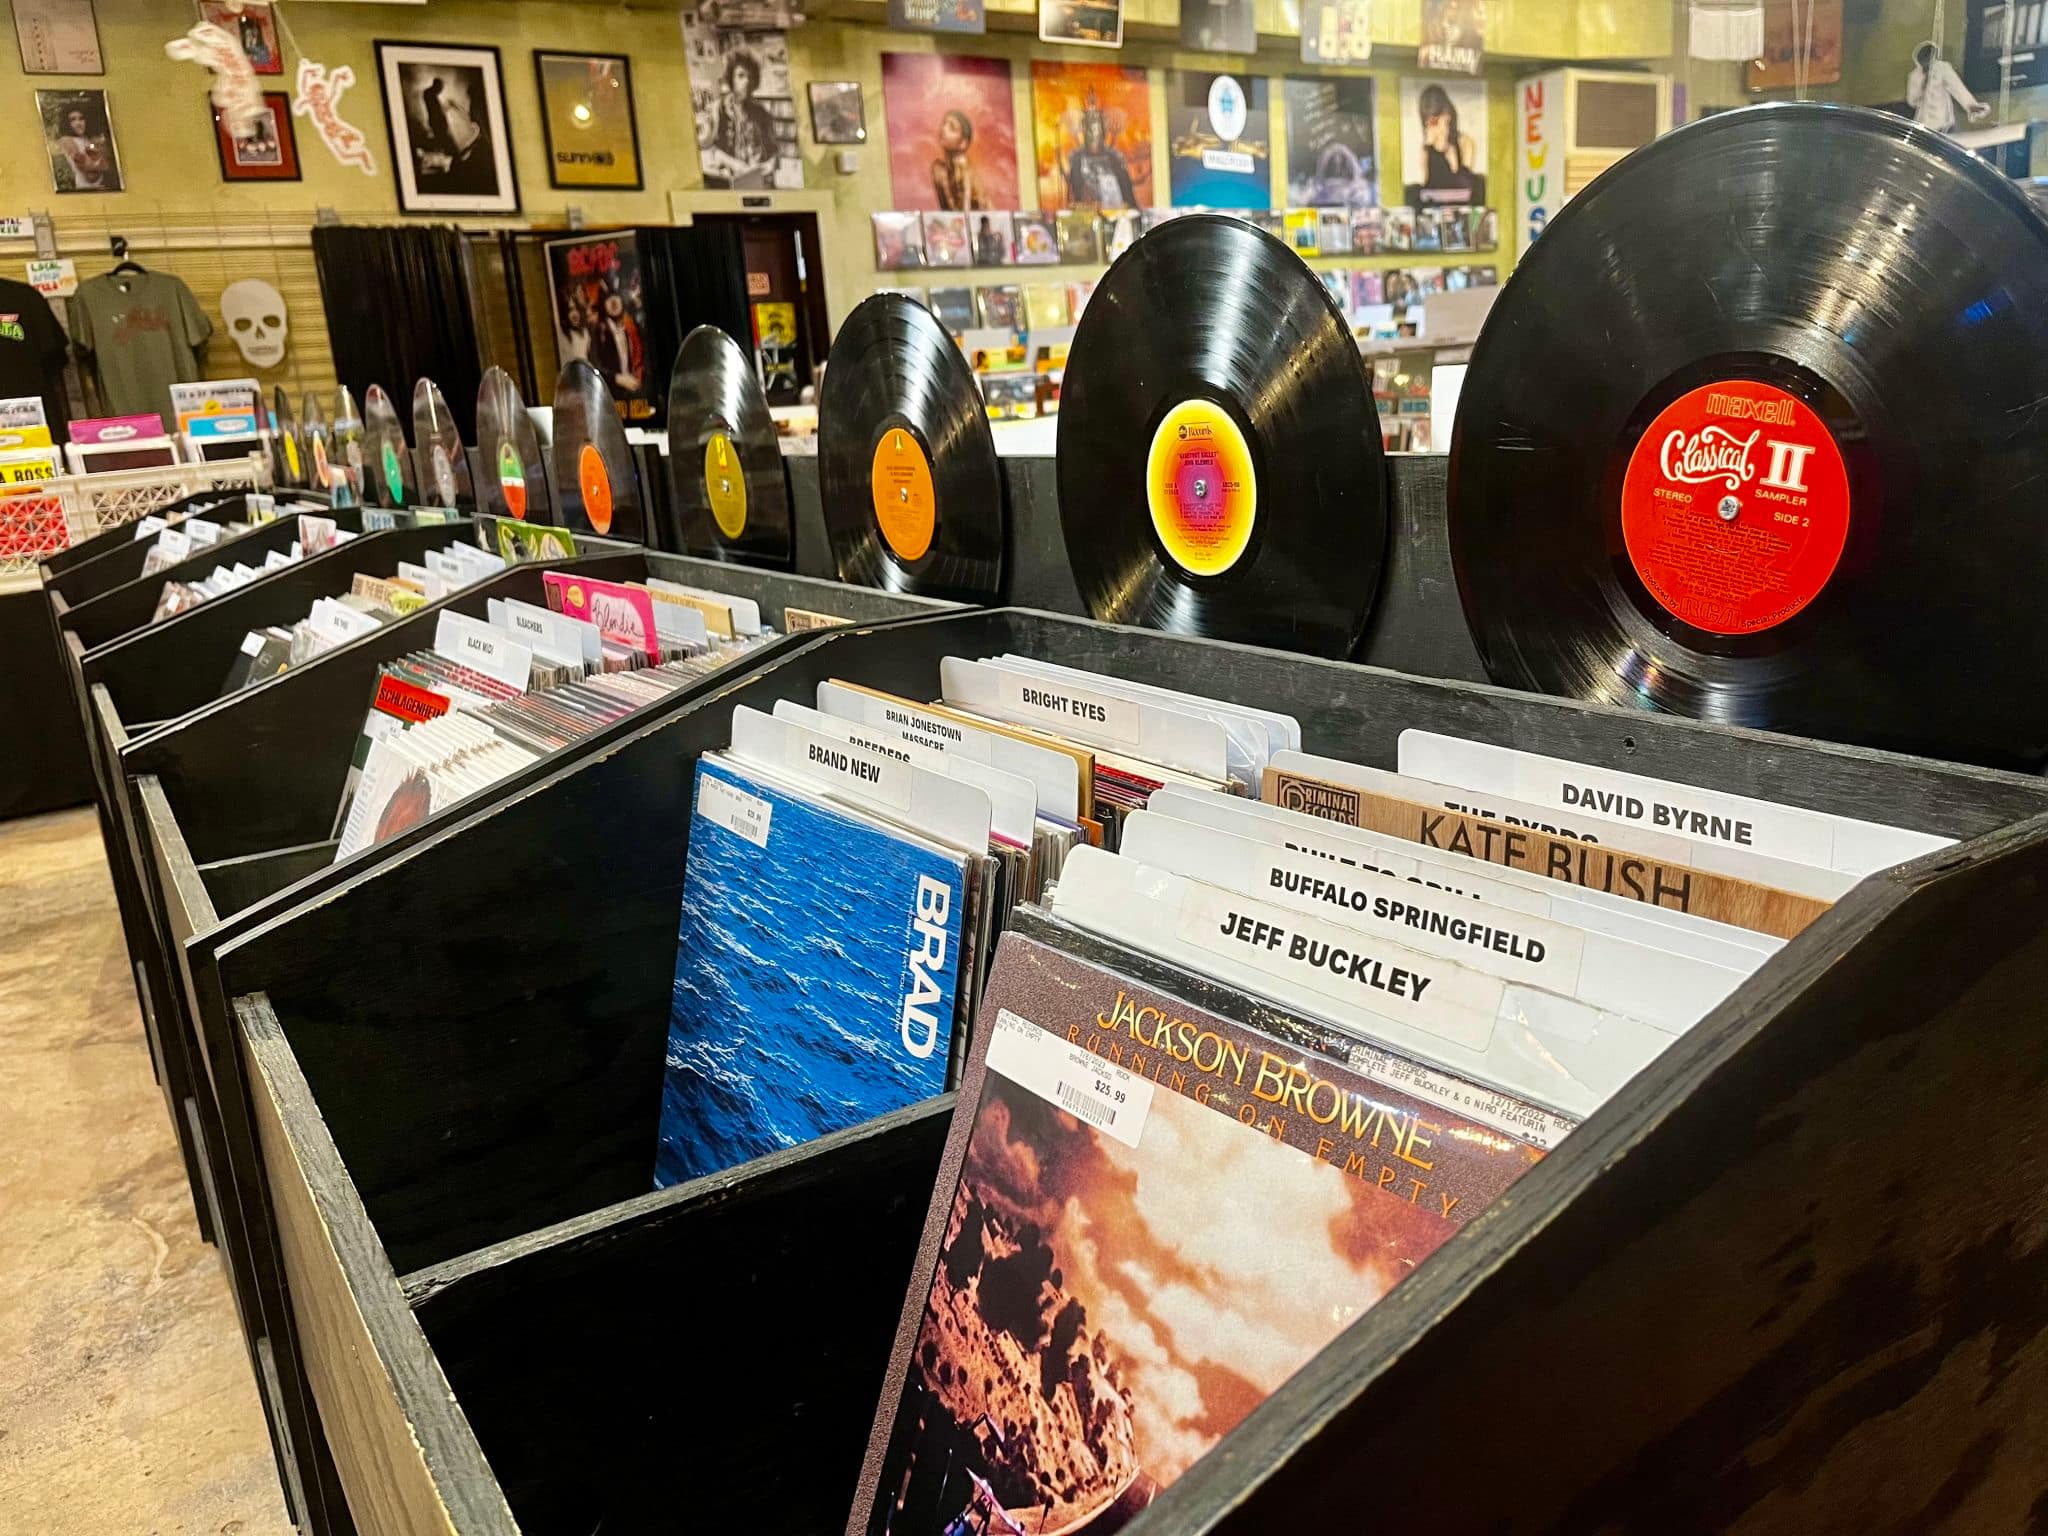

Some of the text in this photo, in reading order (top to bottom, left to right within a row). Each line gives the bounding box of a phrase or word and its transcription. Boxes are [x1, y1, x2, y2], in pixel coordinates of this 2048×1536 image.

[1706, 393, 1794, 425] maxell
[14, 466, 54, 482] BOSS
[1660, 425, 1815, 492] Classical II
[1653, 487, 1693, 504] STEREO
[1754, 488, 1808, 507] SAMPLER
[1773, 511, 1810, 527] SIDE 2
[516, 616, 543, 634] BLEACHERS
[592, 597, 645, 638] Blondie
[1680, 595, 1740, 628] RCA
[468, 636, 481, 650] BLACK
[1022, 687, 1106, 722] BRIGHT EYES
[886, 709, 962, 742] BRIAN JONESTOWN
[808, 743, 881, 784] BRAND NEW
[1562, 783, 1753, 846] DAVID BYRNE
[1420, 811, 1527, 867] KATE
[1547, 842, 1691, 913] BUSH
[1269, 867, 1368, 912] BUFFALO
[1372, 897, 1546, 963] SPRINGFIELD
[902, 874, 951, 1059] BRAD
[1220, 912, 1432, 1002] JEFF BUCKLEY
[1096, 990, 1442, 1171] JACKSON BROWNE
[1391, 1058, 1428, 1080] RECORDS
[1095, 1079, 1127, 1104] $25.99
[1389, 1068, 1411, 1082] JEFF
[1413, 1077, 1449, 1097] BUCKLEY
[1453, 1091, 1460, 1101] &
[1500, 1107, 1547, 1134] FEATURIN
[1066, 1023, 1459, 1218] RUNNING ON EMPTY
